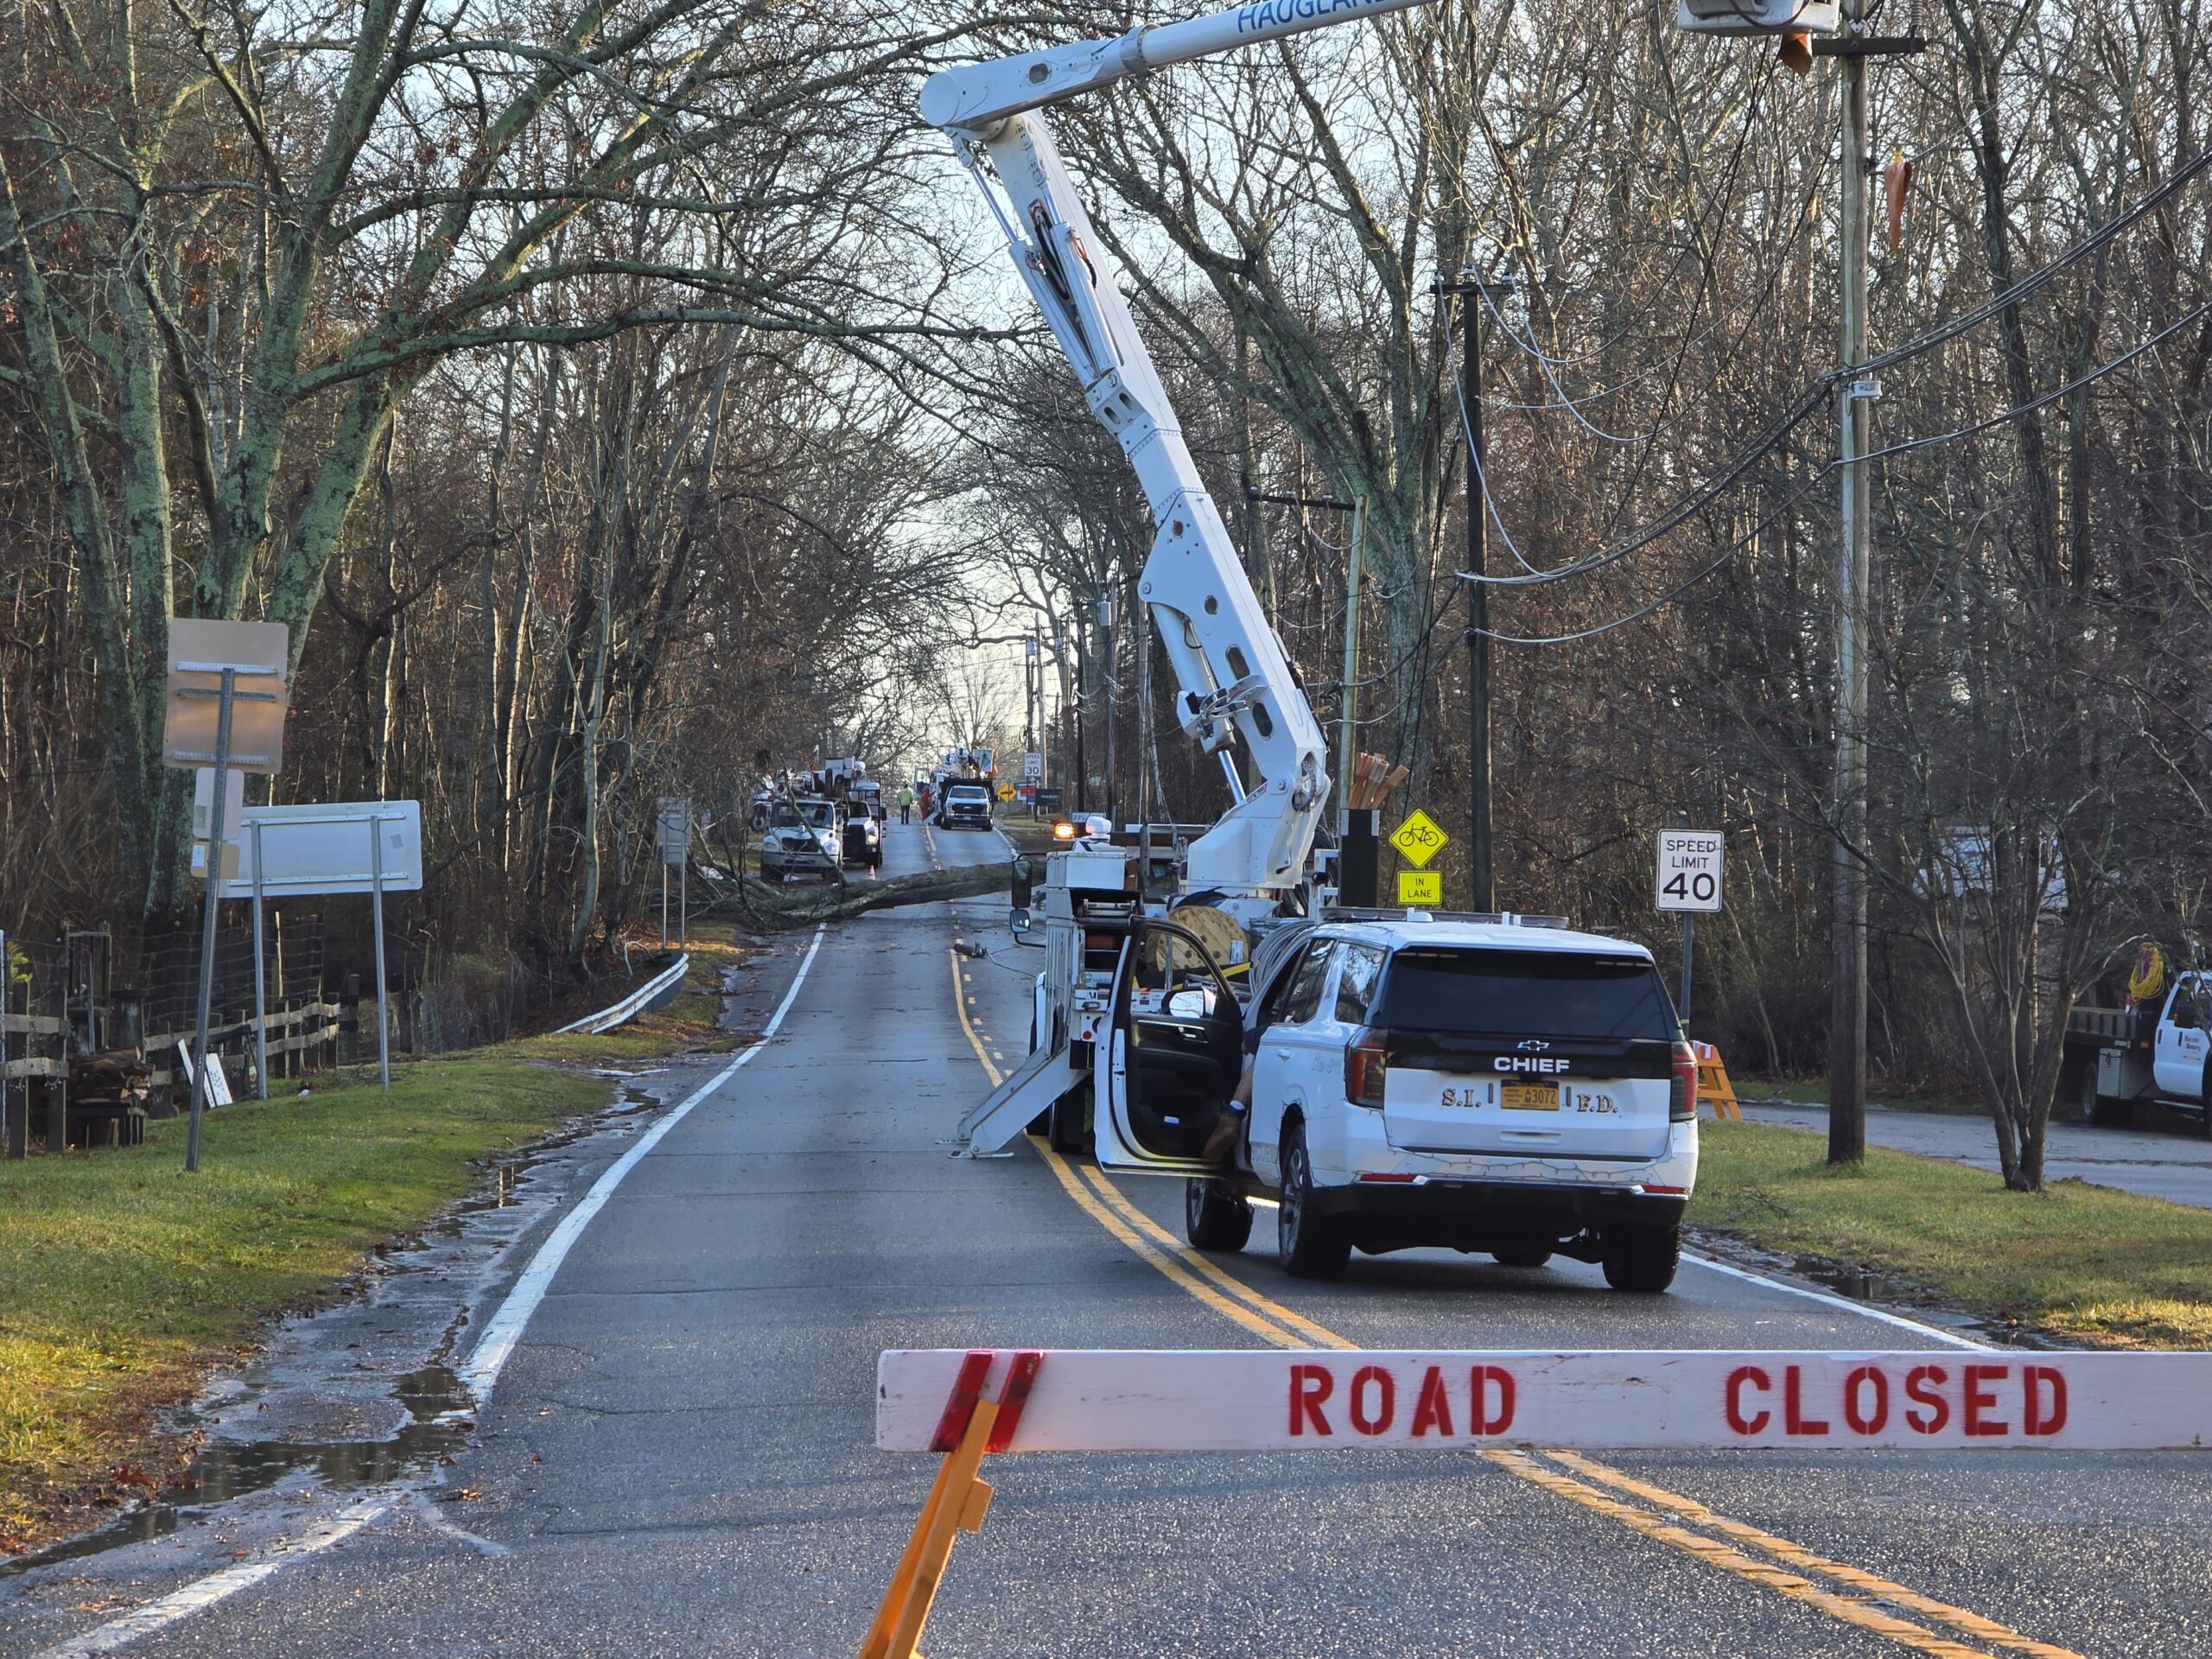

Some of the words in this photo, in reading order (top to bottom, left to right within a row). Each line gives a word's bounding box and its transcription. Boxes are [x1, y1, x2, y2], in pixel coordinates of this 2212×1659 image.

[1666, 839, 1717, 853] SPEED
[1672, 855, 1710, 868] LIMIT
[1414, 877, 1425, 887] IN
[1662, 872, 1716, 901] 40
[1408, 889, 1433, 898] LANE
[1493, 1056, 1571, 1073] CHIEF
[1441, 1087, 1483, 1108] S.I.
[1576, 1093, 1620, 1114] F.D.
[1288, 1364, 1516, 1436] ROAD
[1726, 1365, 2069, 1436] CLOSED
